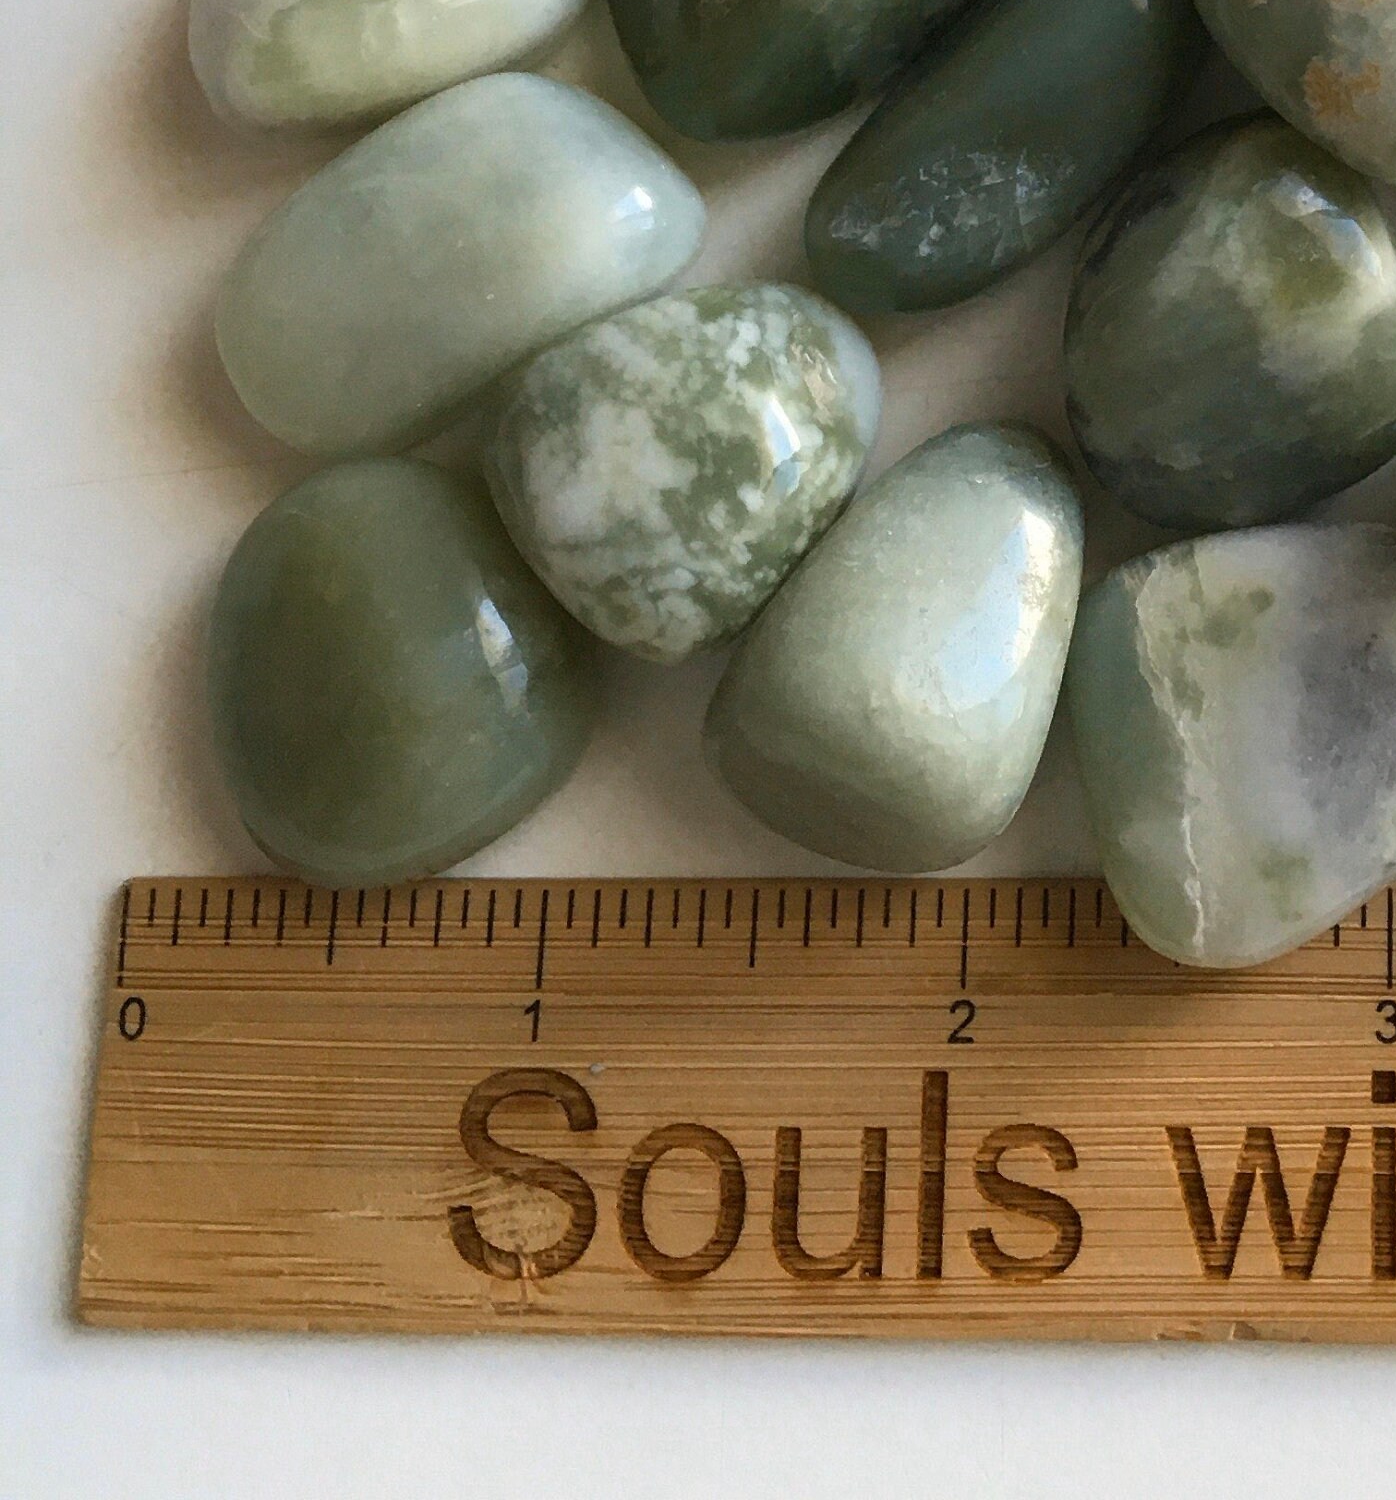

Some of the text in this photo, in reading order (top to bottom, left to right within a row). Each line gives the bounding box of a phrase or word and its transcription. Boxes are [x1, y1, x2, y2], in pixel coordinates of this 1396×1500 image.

[118, 998, 147, 1043] 0
[523, 999, 541, 1043] 1
[945, 999, 976, 1044] 2
[448, 1066, 1084, 1283] Souls
